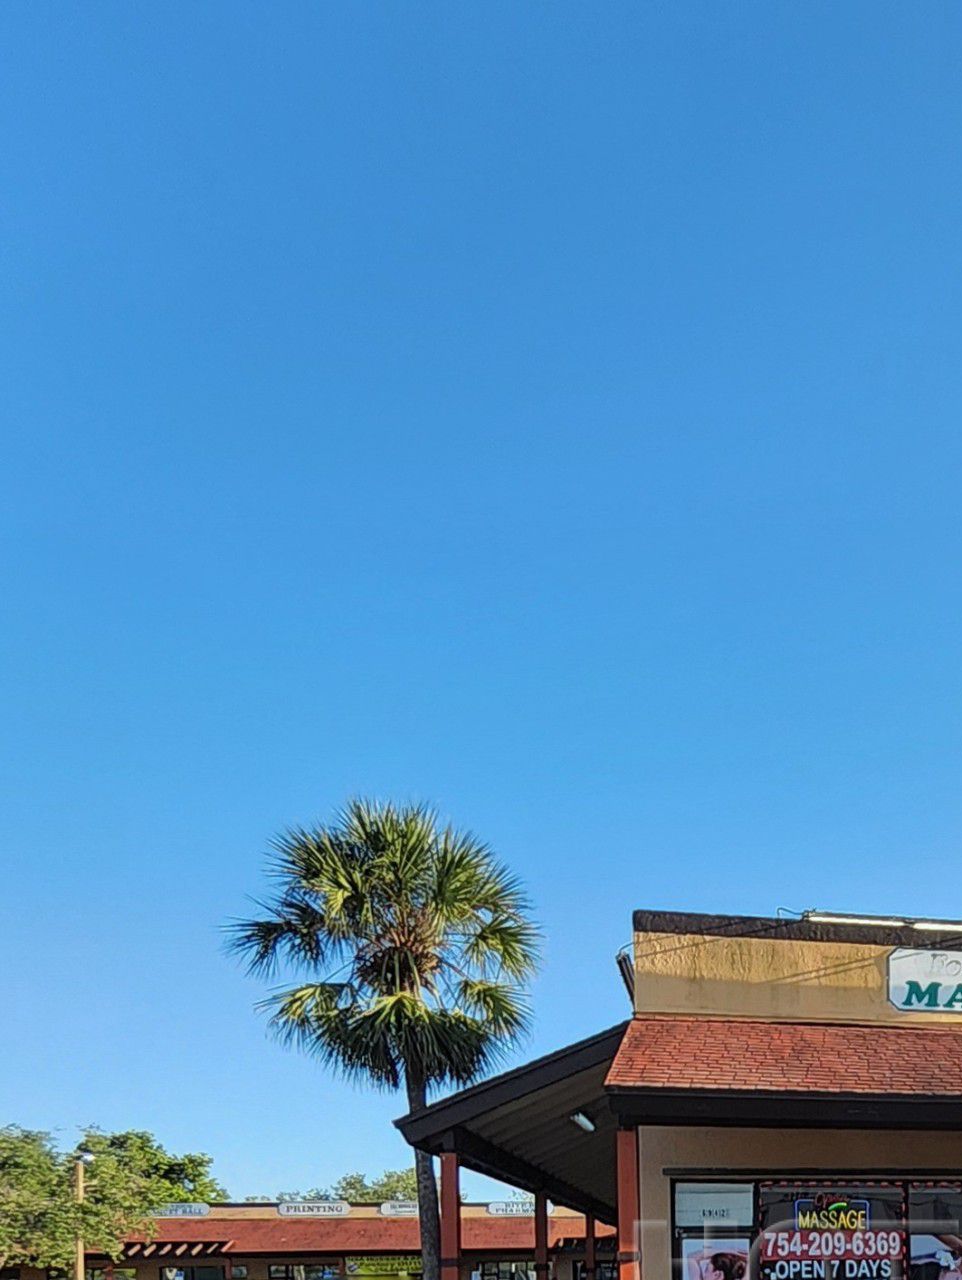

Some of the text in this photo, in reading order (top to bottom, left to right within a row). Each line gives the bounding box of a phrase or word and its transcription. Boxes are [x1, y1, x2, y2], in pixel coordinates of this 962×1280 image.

[285, 1205, 343, 1213] PRINTING
[798, 1209, 866, 1230] MASSAGE
[764, 1231, 902, 1257] 754-209-6369
[775, 1259, 892, 1279] OPEN 7 DAYS
